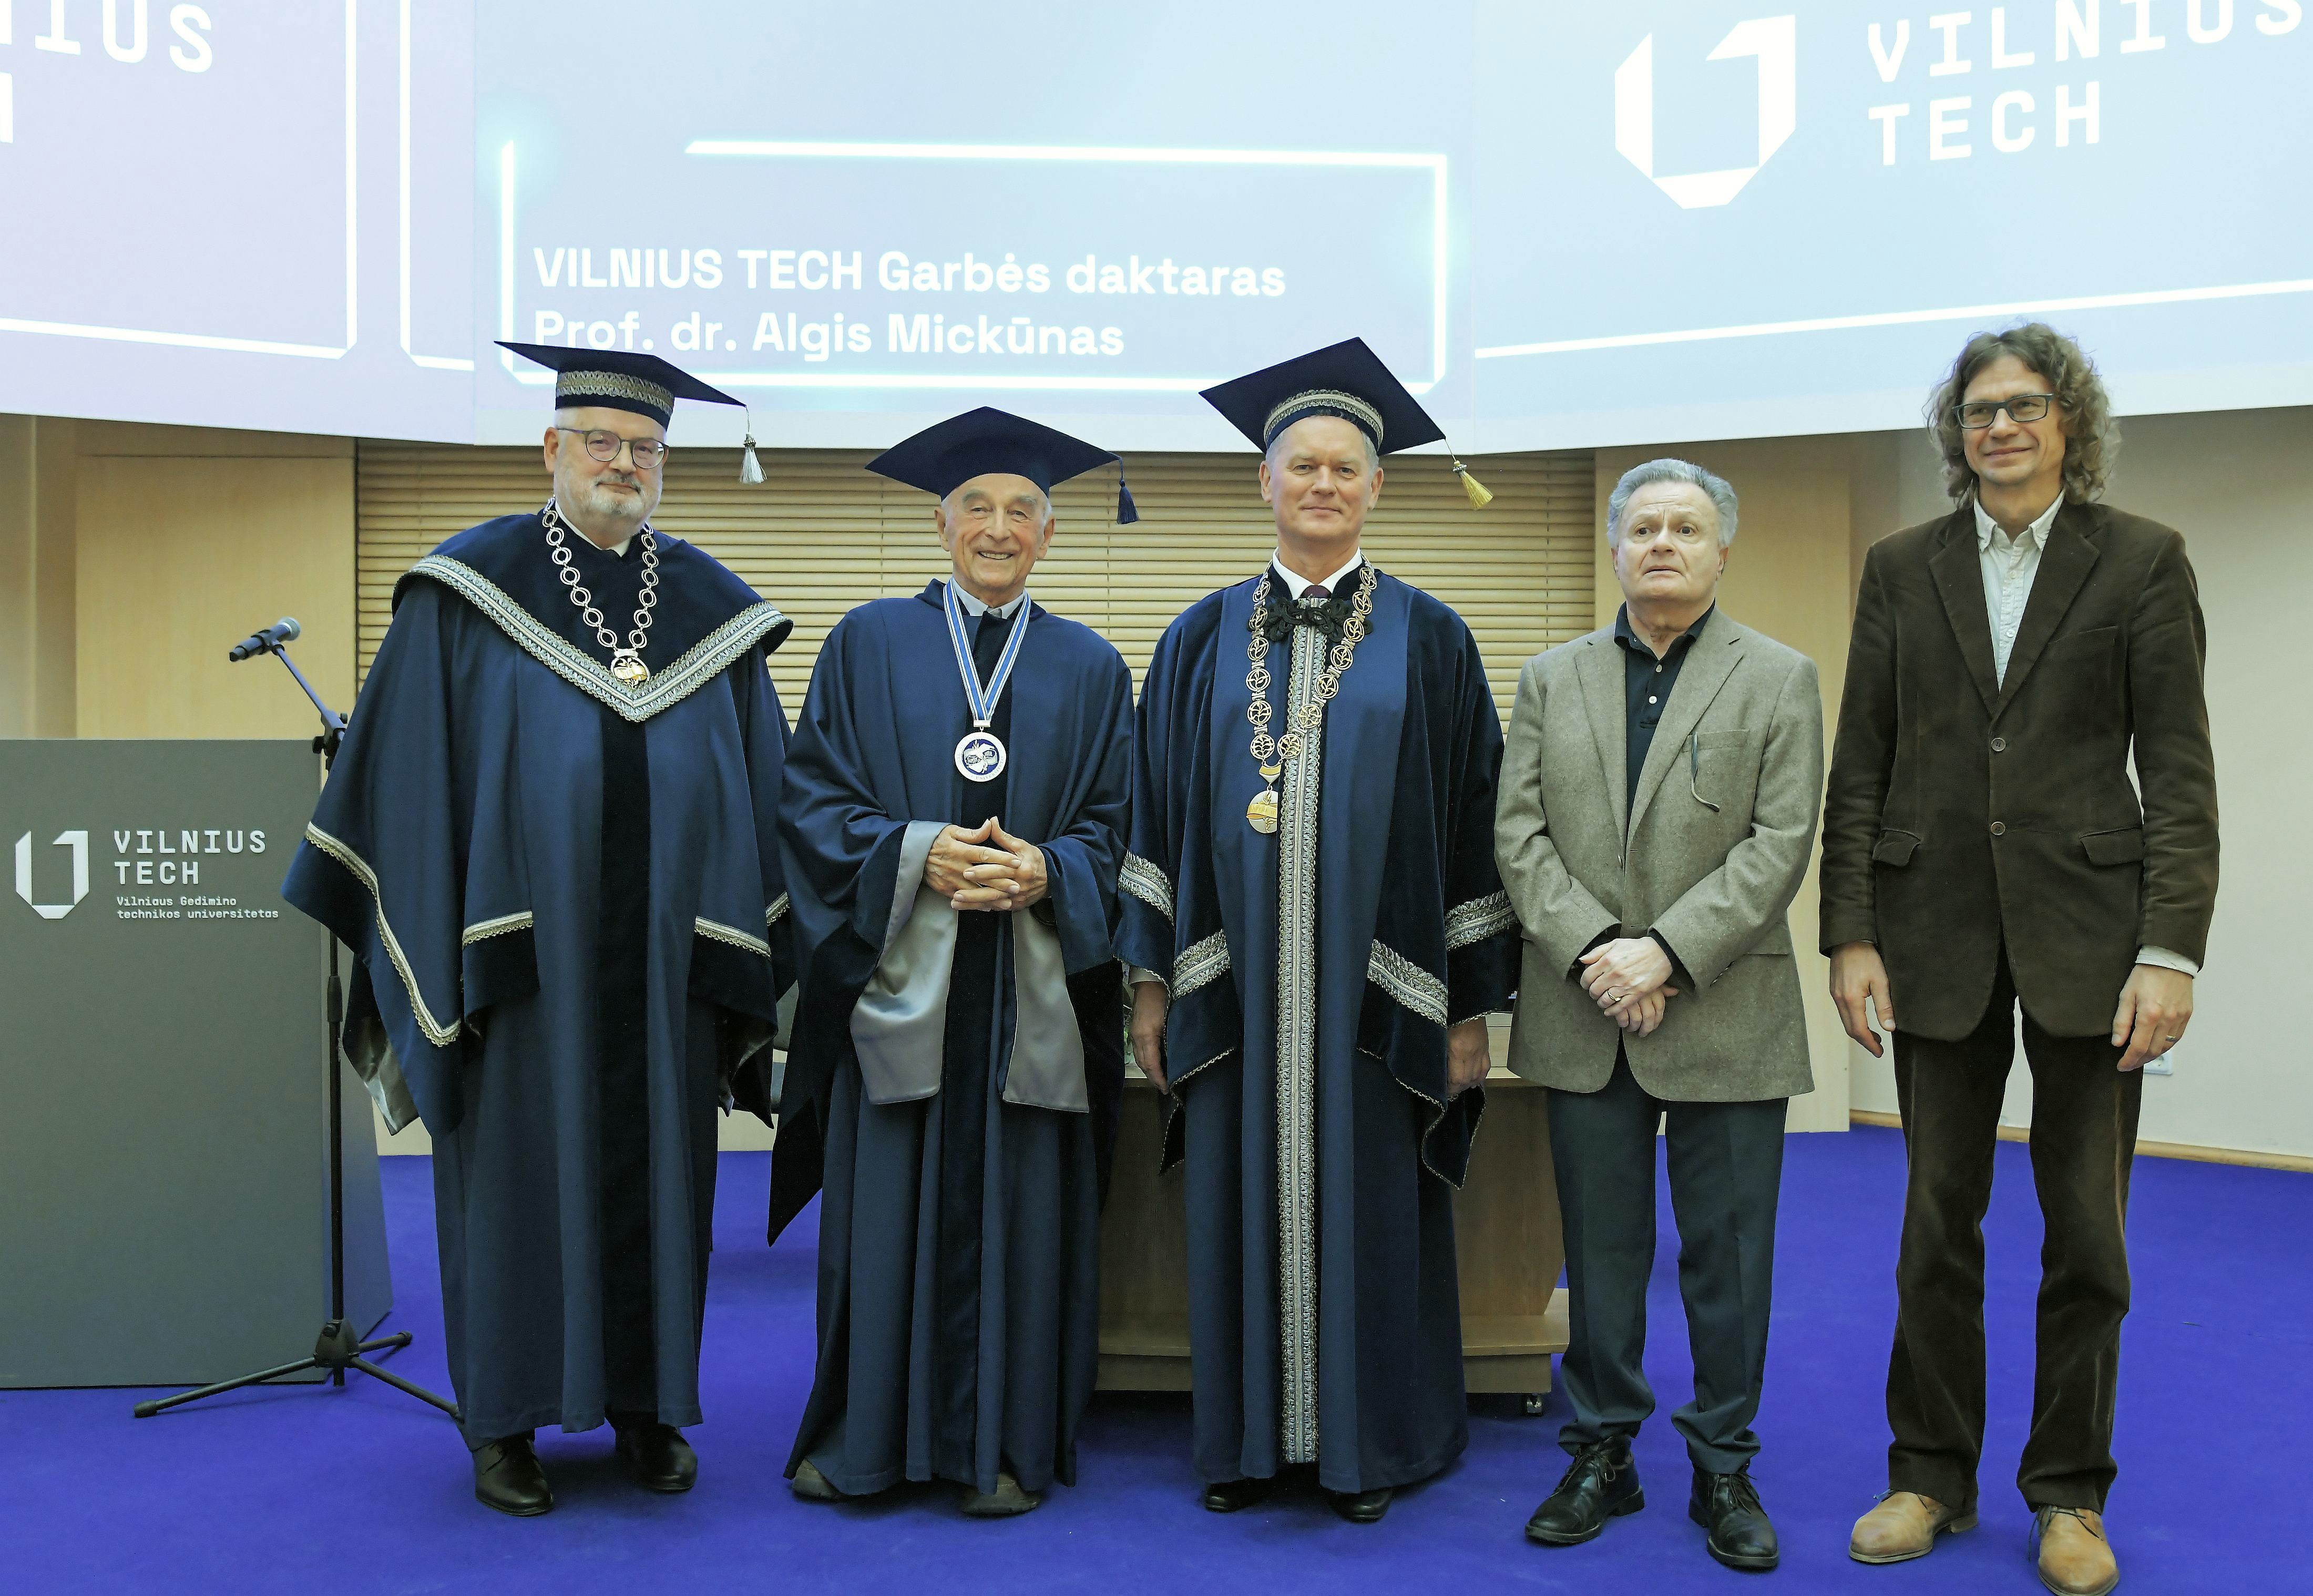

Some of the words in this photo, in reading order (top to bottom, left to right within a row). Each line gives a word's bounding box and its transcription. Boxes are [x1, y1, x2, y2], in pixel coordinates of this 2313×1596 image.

[0, 0, 213, 73] IUS
[1868, 81, 2100, 166] TECH
[534, 248, 723, 289] VILNIUS
[737, 250, 862, 290] TECH
[878, 251, 1050, 293] Garbės
[1066, 254, 1286, 297] daktaras
[535, 310, 654, 351] Prof.
[671, 311, 737, 351] dr.
[753, 312, 872, 362] Algis
[888, 313, 1124, 356] Mickūnas
[114, 830, 266, 854] VILNIUS
[114, 861, 199, 885] TECH
[117, 896, 173, 906] Vilniaus
[180, 896, 237, 906] Gedimino
[117, 909, 180, 919] technikos
[187, 909, 279, 918] universitetas
